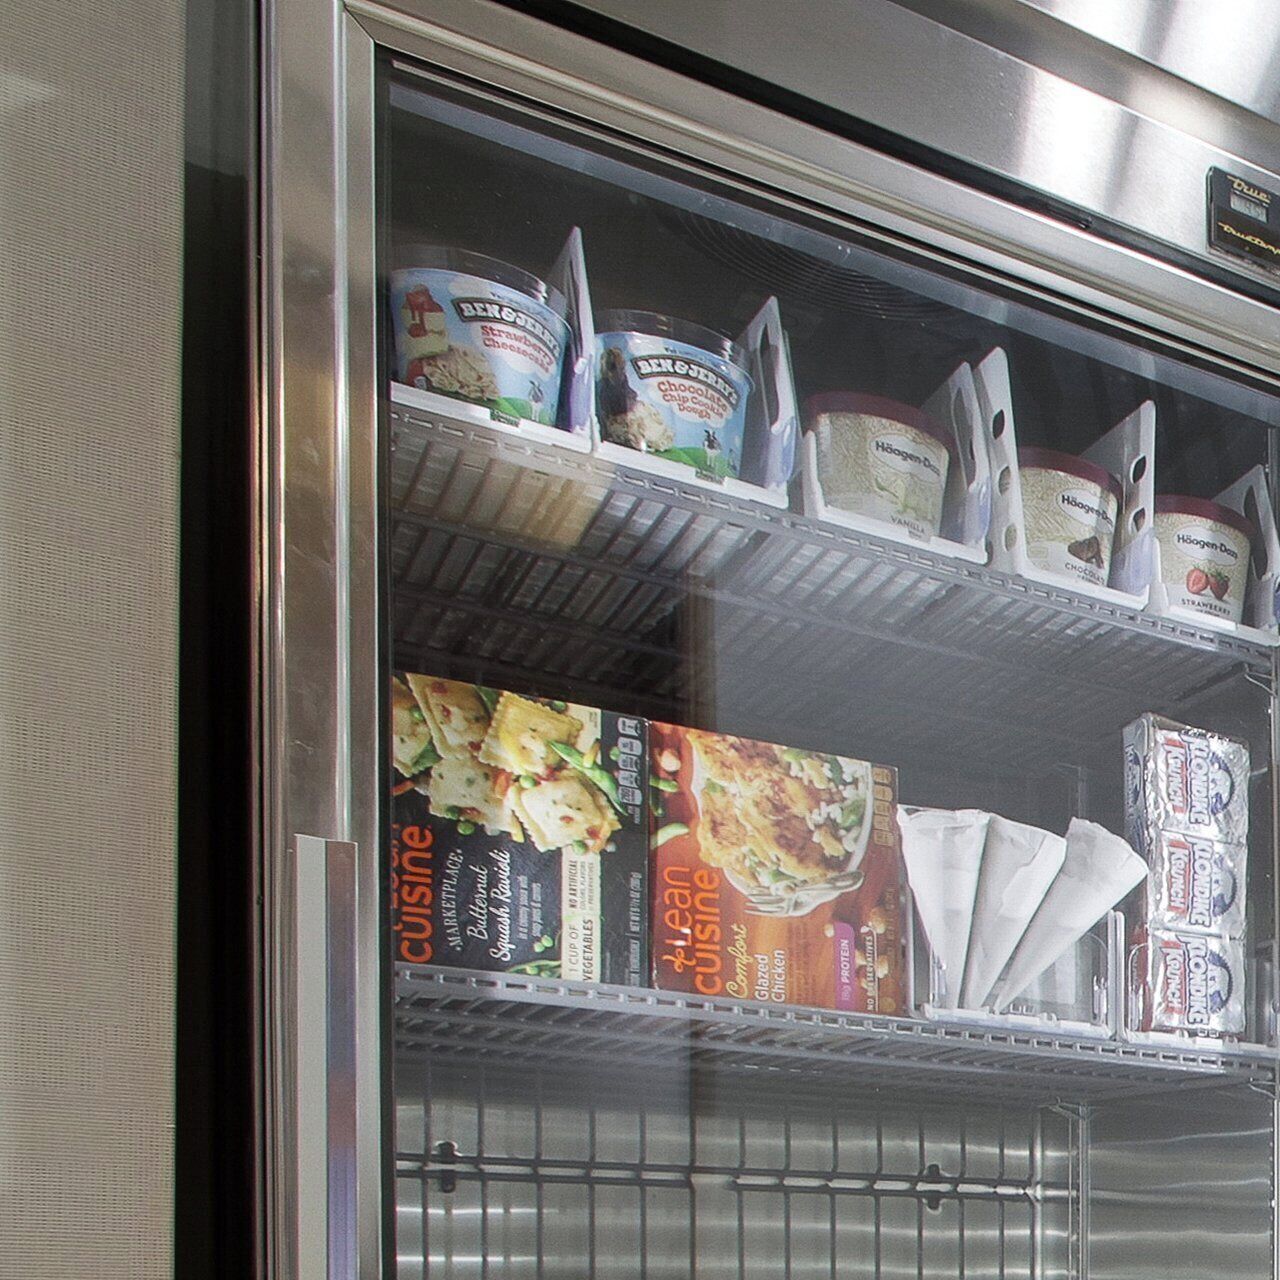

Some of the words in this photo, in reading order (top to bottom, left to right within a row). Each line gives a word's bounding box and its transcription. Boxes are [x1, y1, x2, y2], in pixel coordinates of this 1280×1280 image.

[481, 324, 555, 364] Strawberry
[657, 380, 728, 412] Chocolate
[678, 401, 712, 421] Dough
[396, 825, 434, 963] cuisine
[489, 849, 512, 903] Ravioli
[568, 860, 578, 897] ARTIFICIAL
[467, 864, 489, 940] Butternut
[662, 866, 693, 946] Lean
[489, 904, 516, 962] Squash
[568, 924, 579, 939] OF
[569, 943, 579, 966] CUP
[582, 918, 594, 981] VEGETABLES
[693, 868, 722, 995] cuisine
[725, 923, 754, 999] Comfort
[754, 954, 770, 1000] Glazed
[771, 950, 786, 1002] Chicken
[840, 939, 850, 983] PROTEIN
[867, 999, 874, 1011] NO
